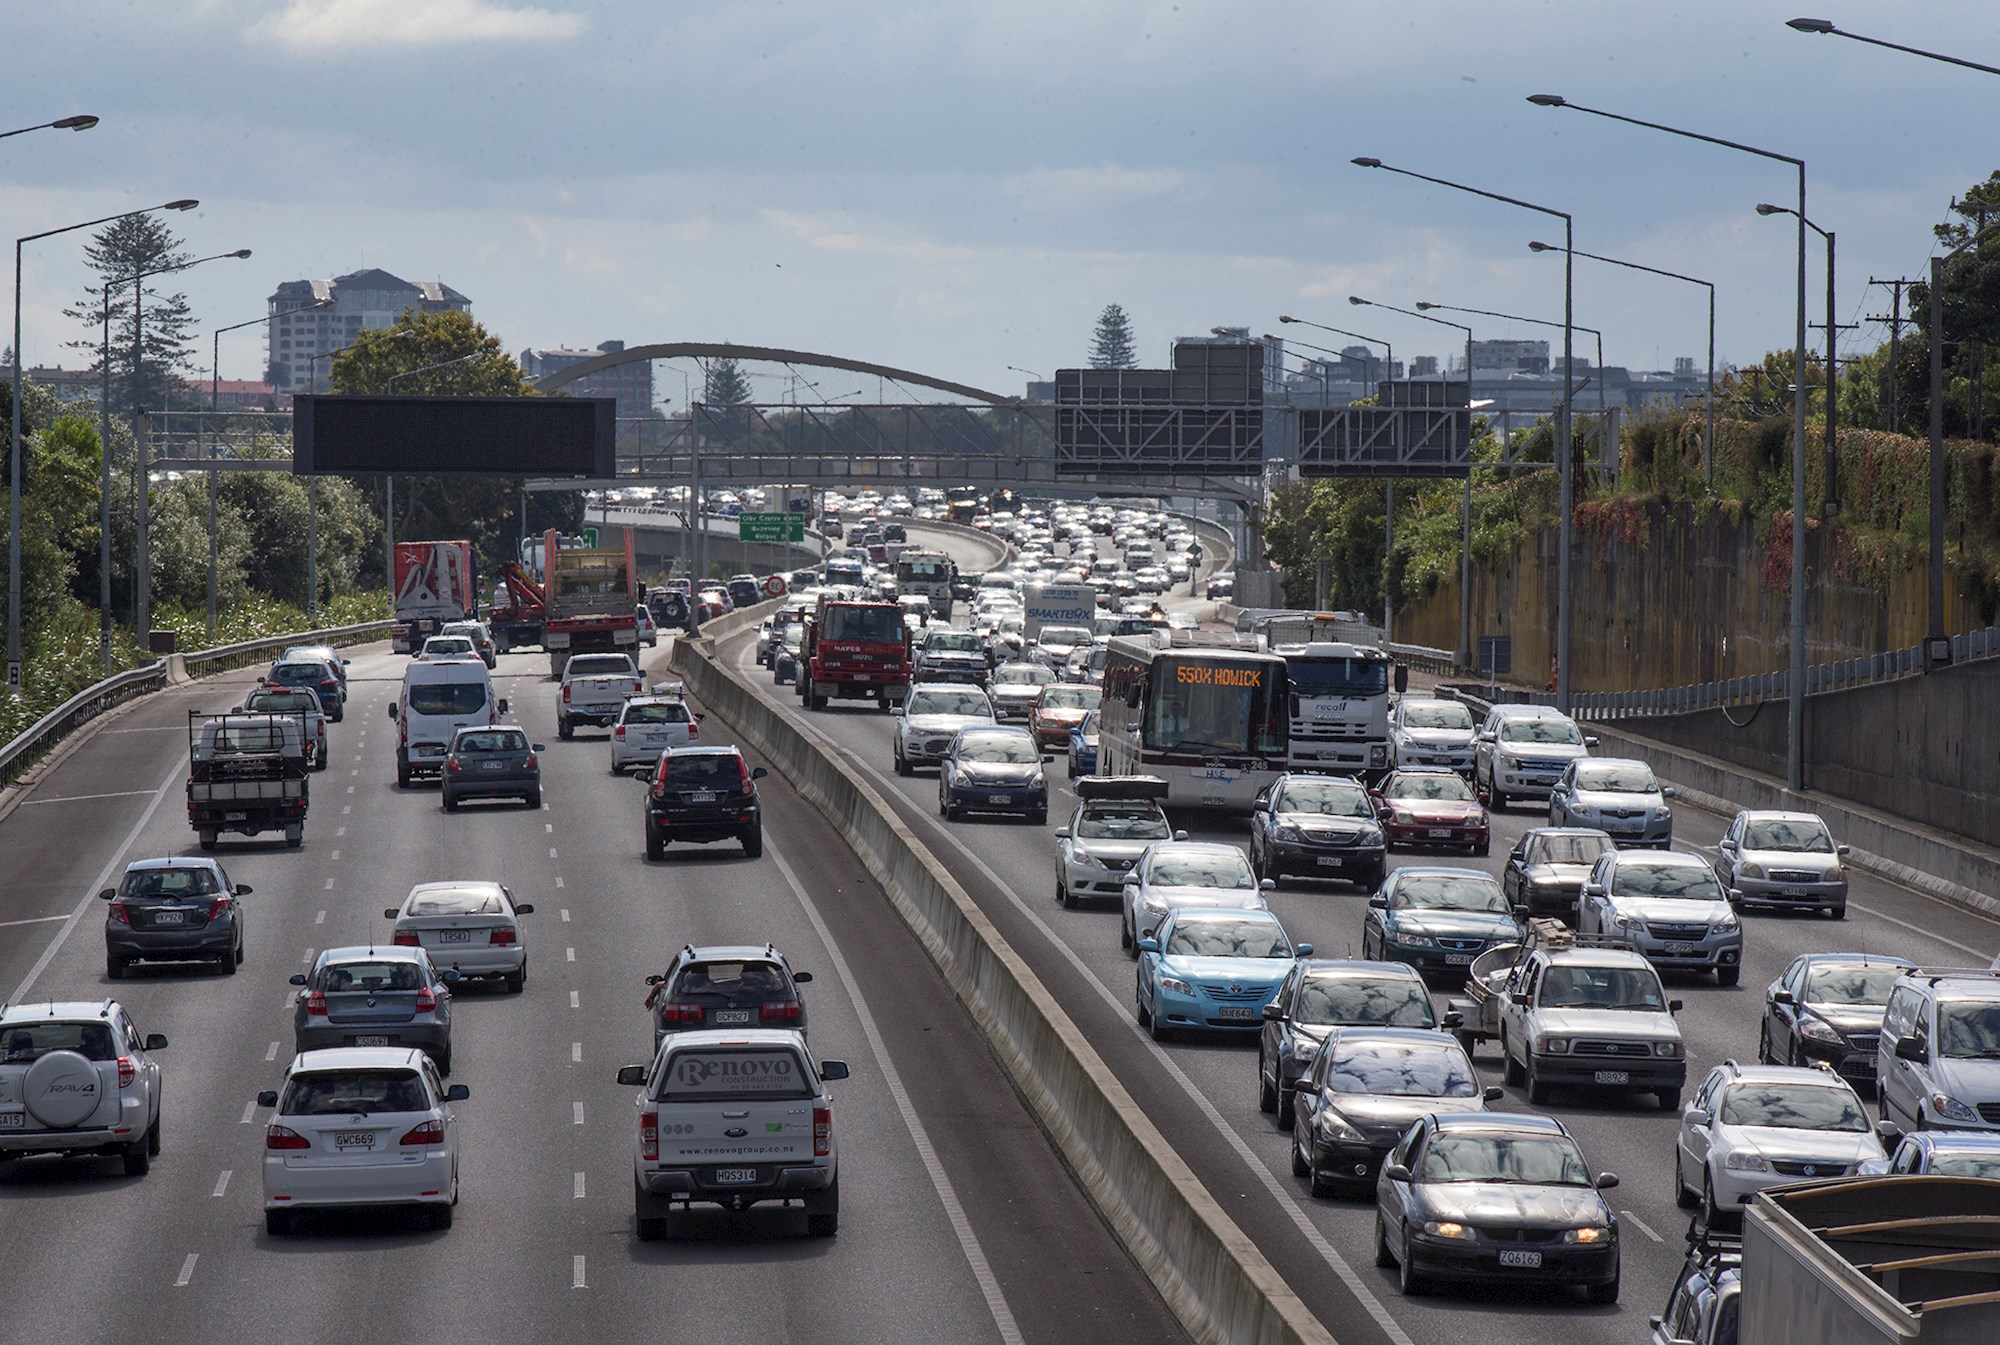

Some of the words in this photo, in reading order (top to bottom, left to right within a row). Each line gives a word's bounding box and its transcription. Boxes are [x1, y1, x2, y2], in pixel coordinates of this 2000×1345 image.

[1028, 607, 1090, 620] SMARTBOX
[1177, 666, 1212, 685] 550X
[1215, 668, 1261, 687] HOWICK
[1315, 701, 1347, 712] recall
[1251, 761, 1268, 770] 245
[1221, 1009, 1251, 1018] DUE643
[721, 1075, 791, 1084] CONSTRUCTION
[50, 1084, 95, 1093] RAV4
[337, 1134, 374, 1145] GWC669
[679, 1146, 794, 1155] www.renovogroup.co.nz
[718, 1170, 755, 1181] HQS314
[1501, 1252, 1541, 1265] ZQ6163
